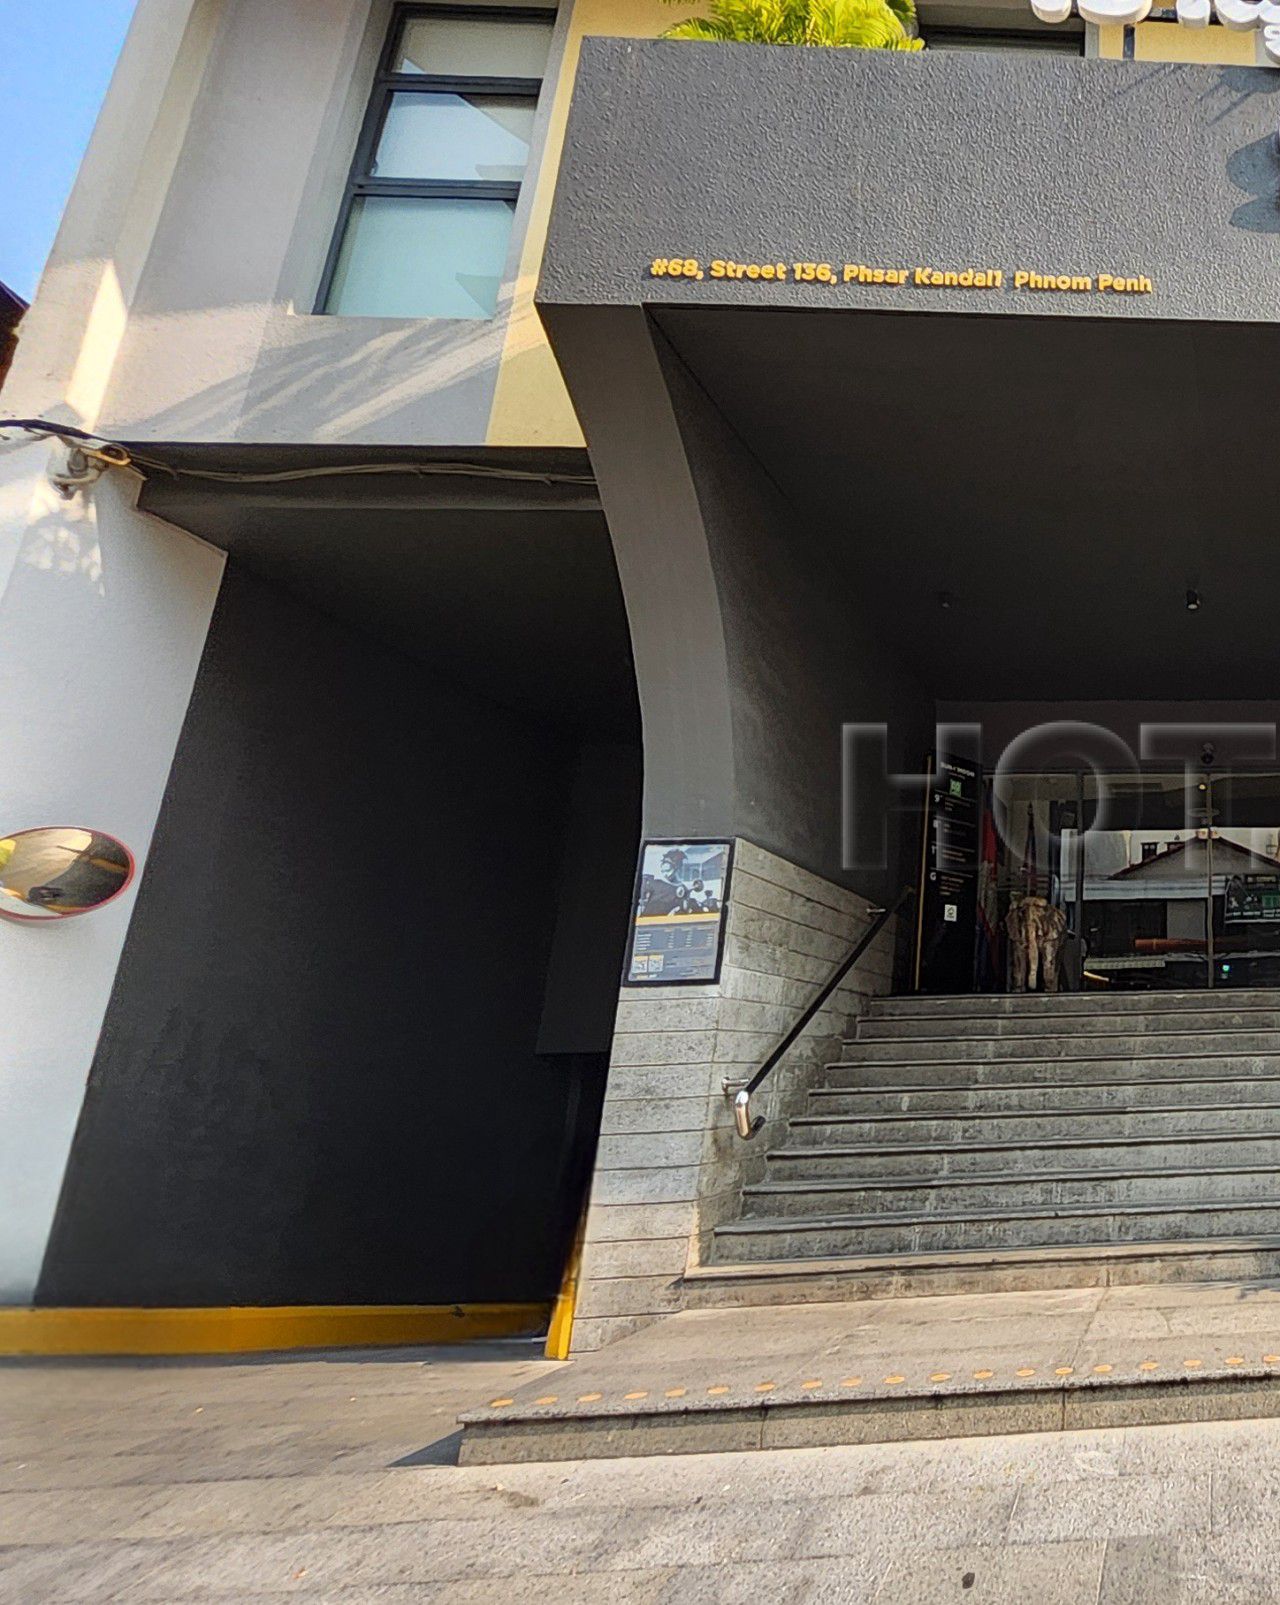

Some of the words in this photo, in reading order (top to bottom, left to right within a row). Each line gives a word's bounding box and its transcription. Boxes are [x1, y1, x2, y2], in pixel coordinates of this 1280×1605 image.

[650, 258, 704, 280] #68,
[710, 260, 786, 280] Street
[793, 262, 837, 284] 136,
[843, 264, 909, 284] Phsar
[1014, 270, 1092, 290] Phnom
[1099, 274, 1153, 292] Penh
